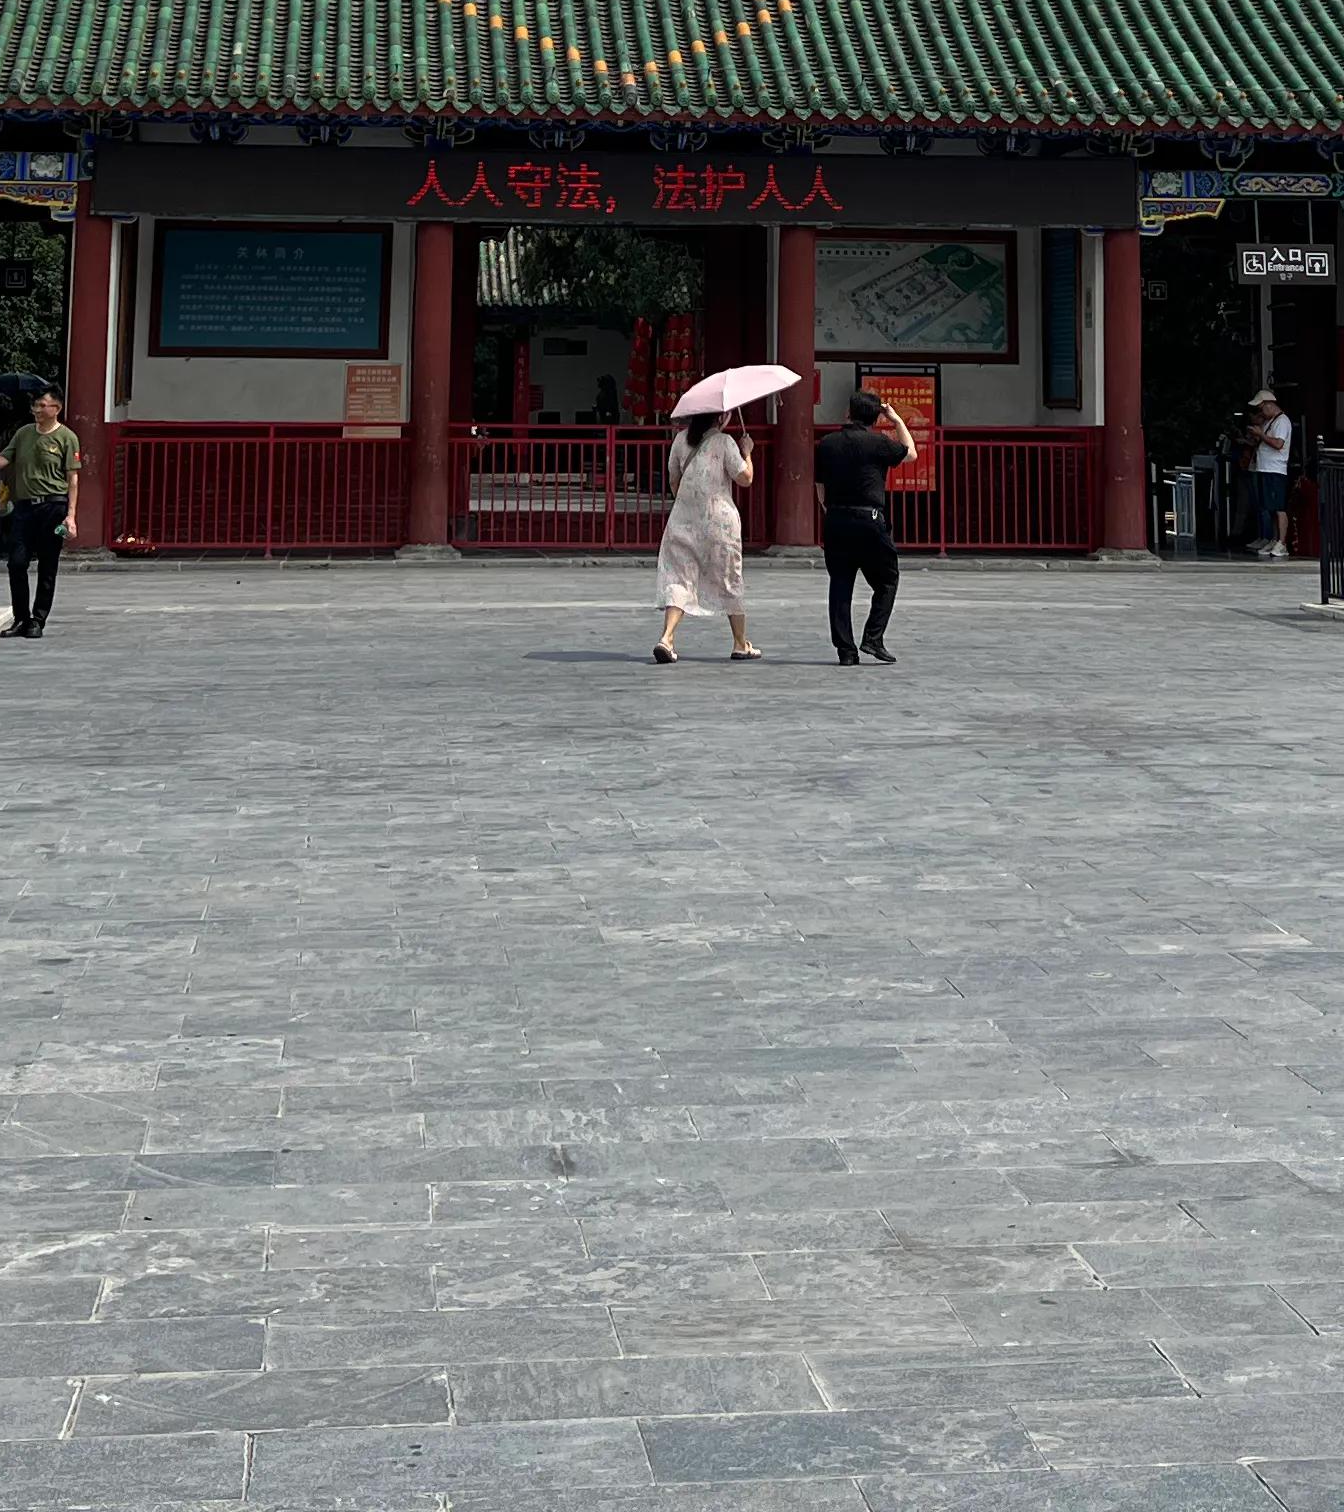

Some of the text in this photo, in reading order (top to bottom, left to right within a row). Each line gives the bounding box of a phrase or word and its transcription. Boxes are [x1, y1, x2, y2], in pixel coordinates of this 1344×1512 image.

[406, 160, 844, 213] 人人守法，法护人人
[1270, 247, 1302, 262] 入口
[1267, 262, 1305, 272] Entrance
[387, 448, 412, 465] JUS
